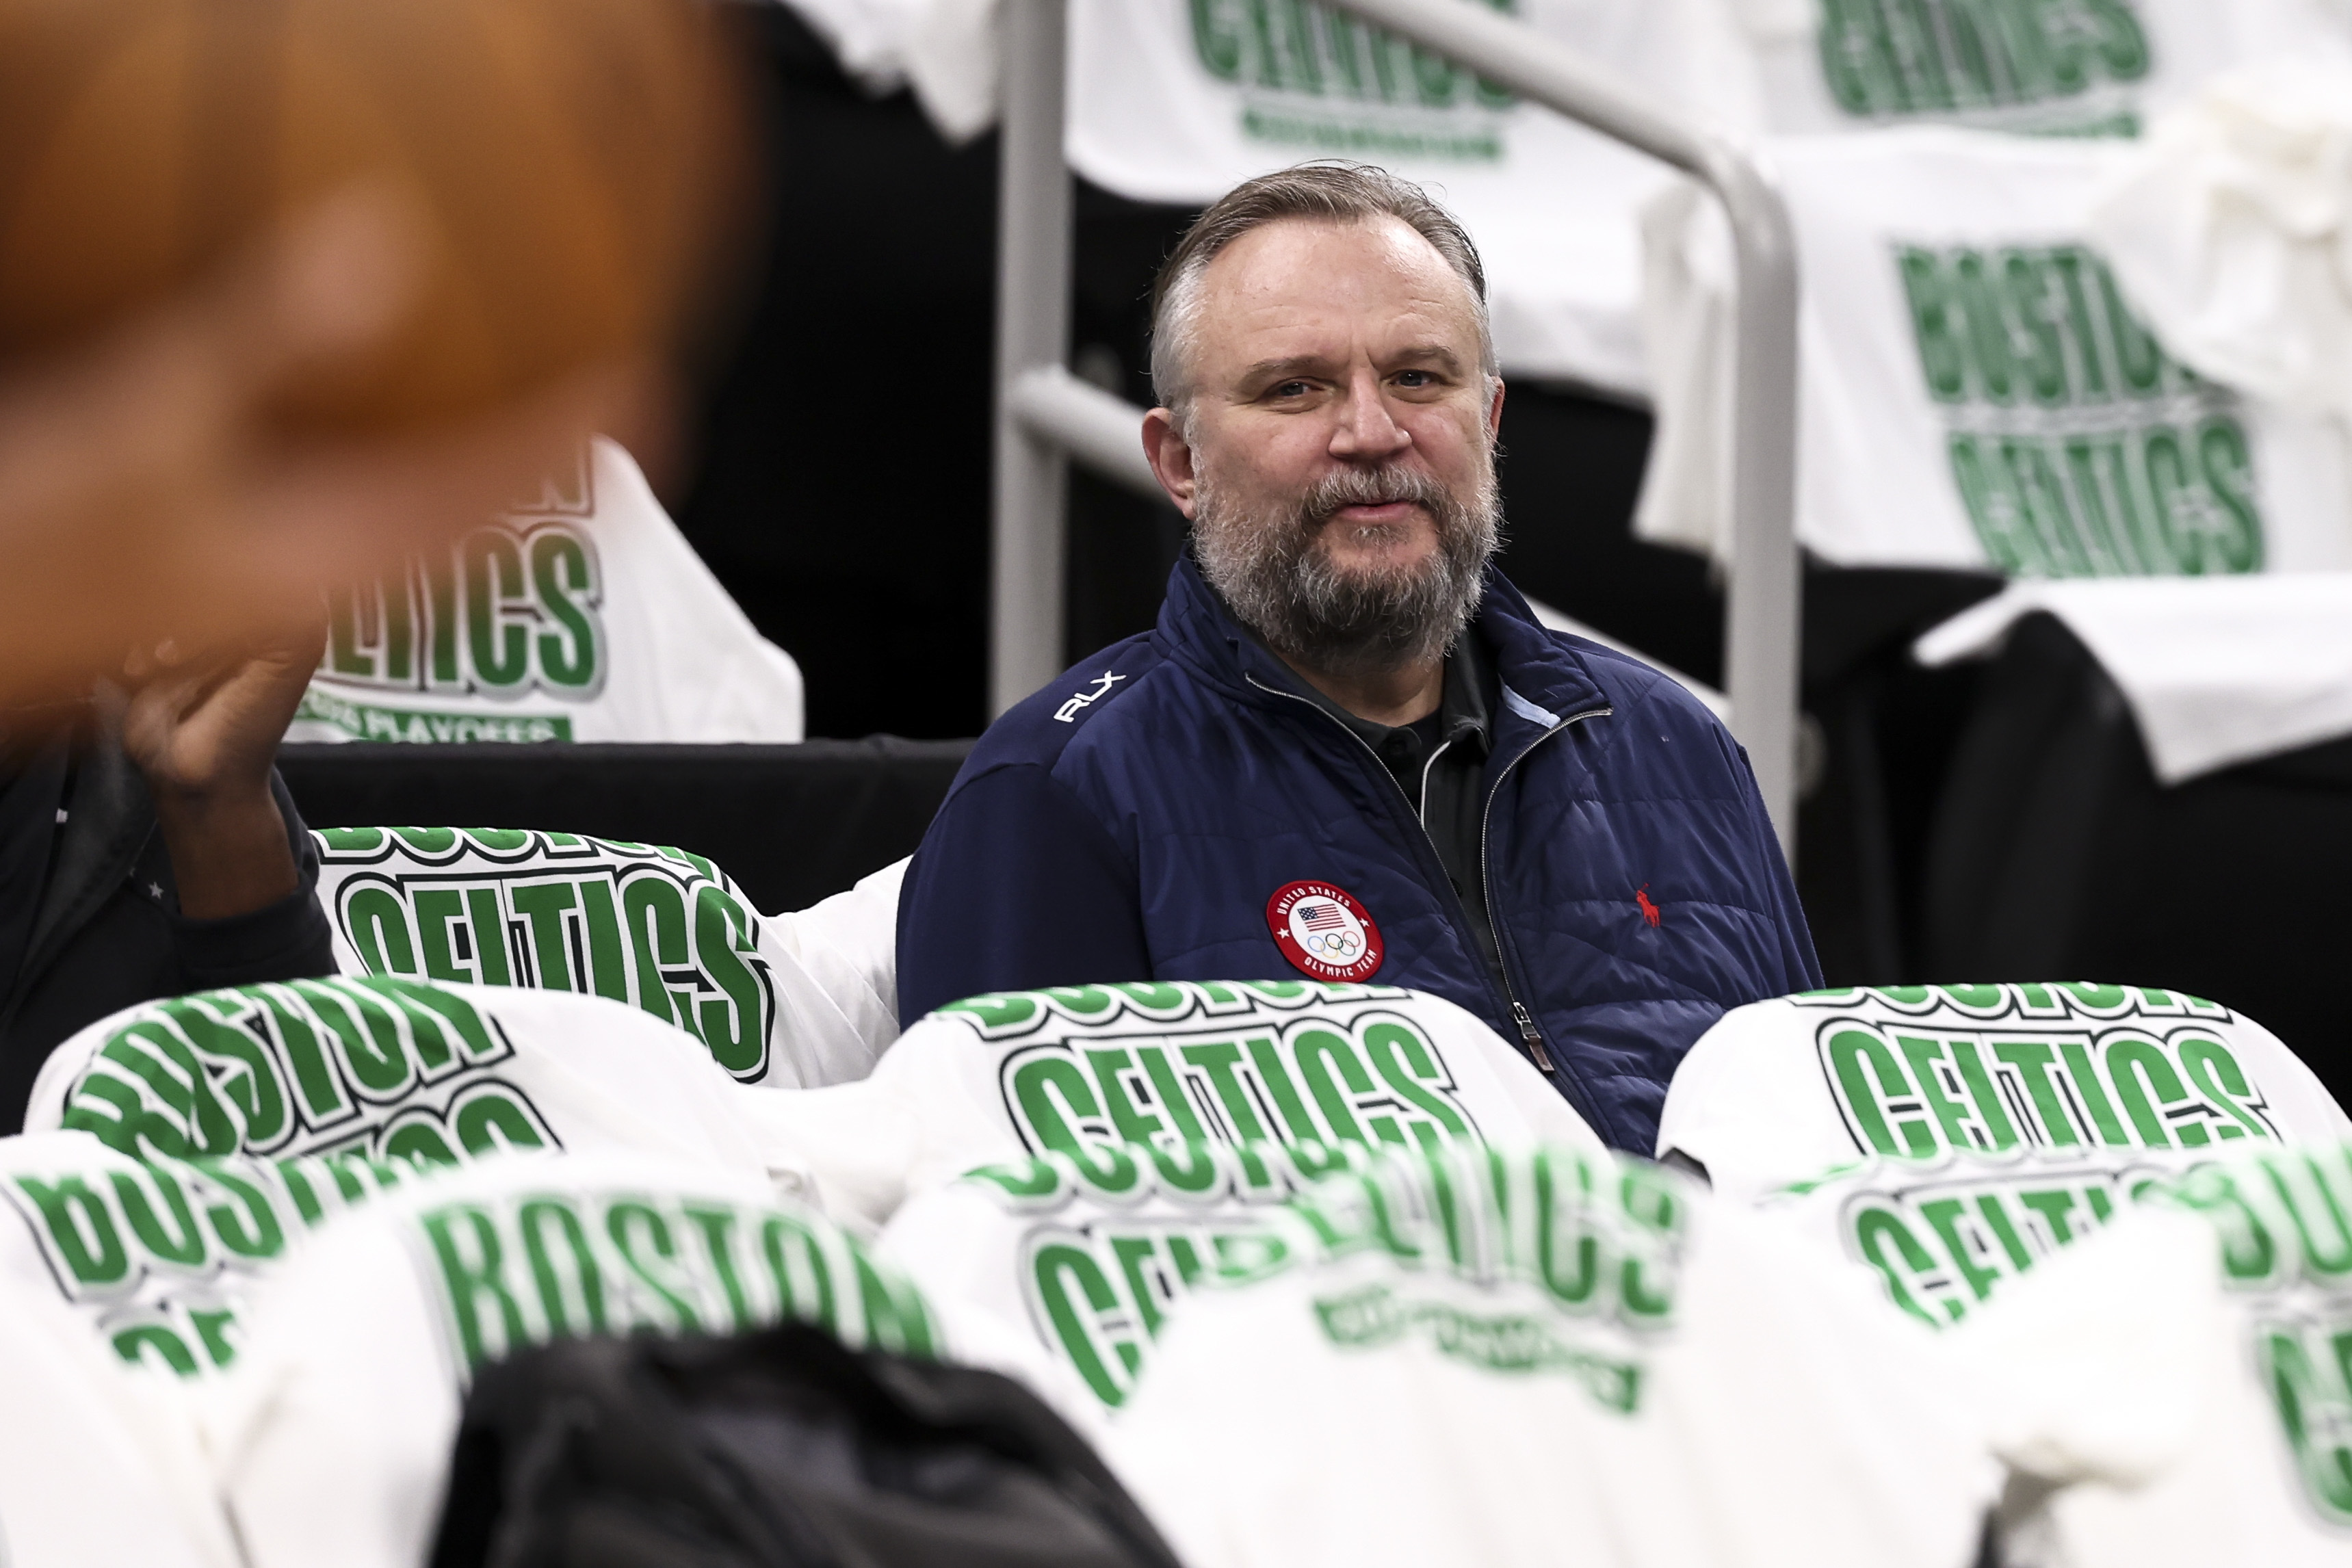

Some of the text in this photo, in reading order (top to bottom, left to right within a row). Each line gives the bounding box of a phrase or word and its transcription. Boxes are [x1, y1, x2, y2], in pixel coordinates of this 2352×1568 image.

[1898, 244, 2198, 399] BOSTO
[1054, 670, 1127, 722] RLX
[1277, 886, 1351, 915] UNITED STATES
[1304, 948, 1377, 977] OLYMPIC TEAM
